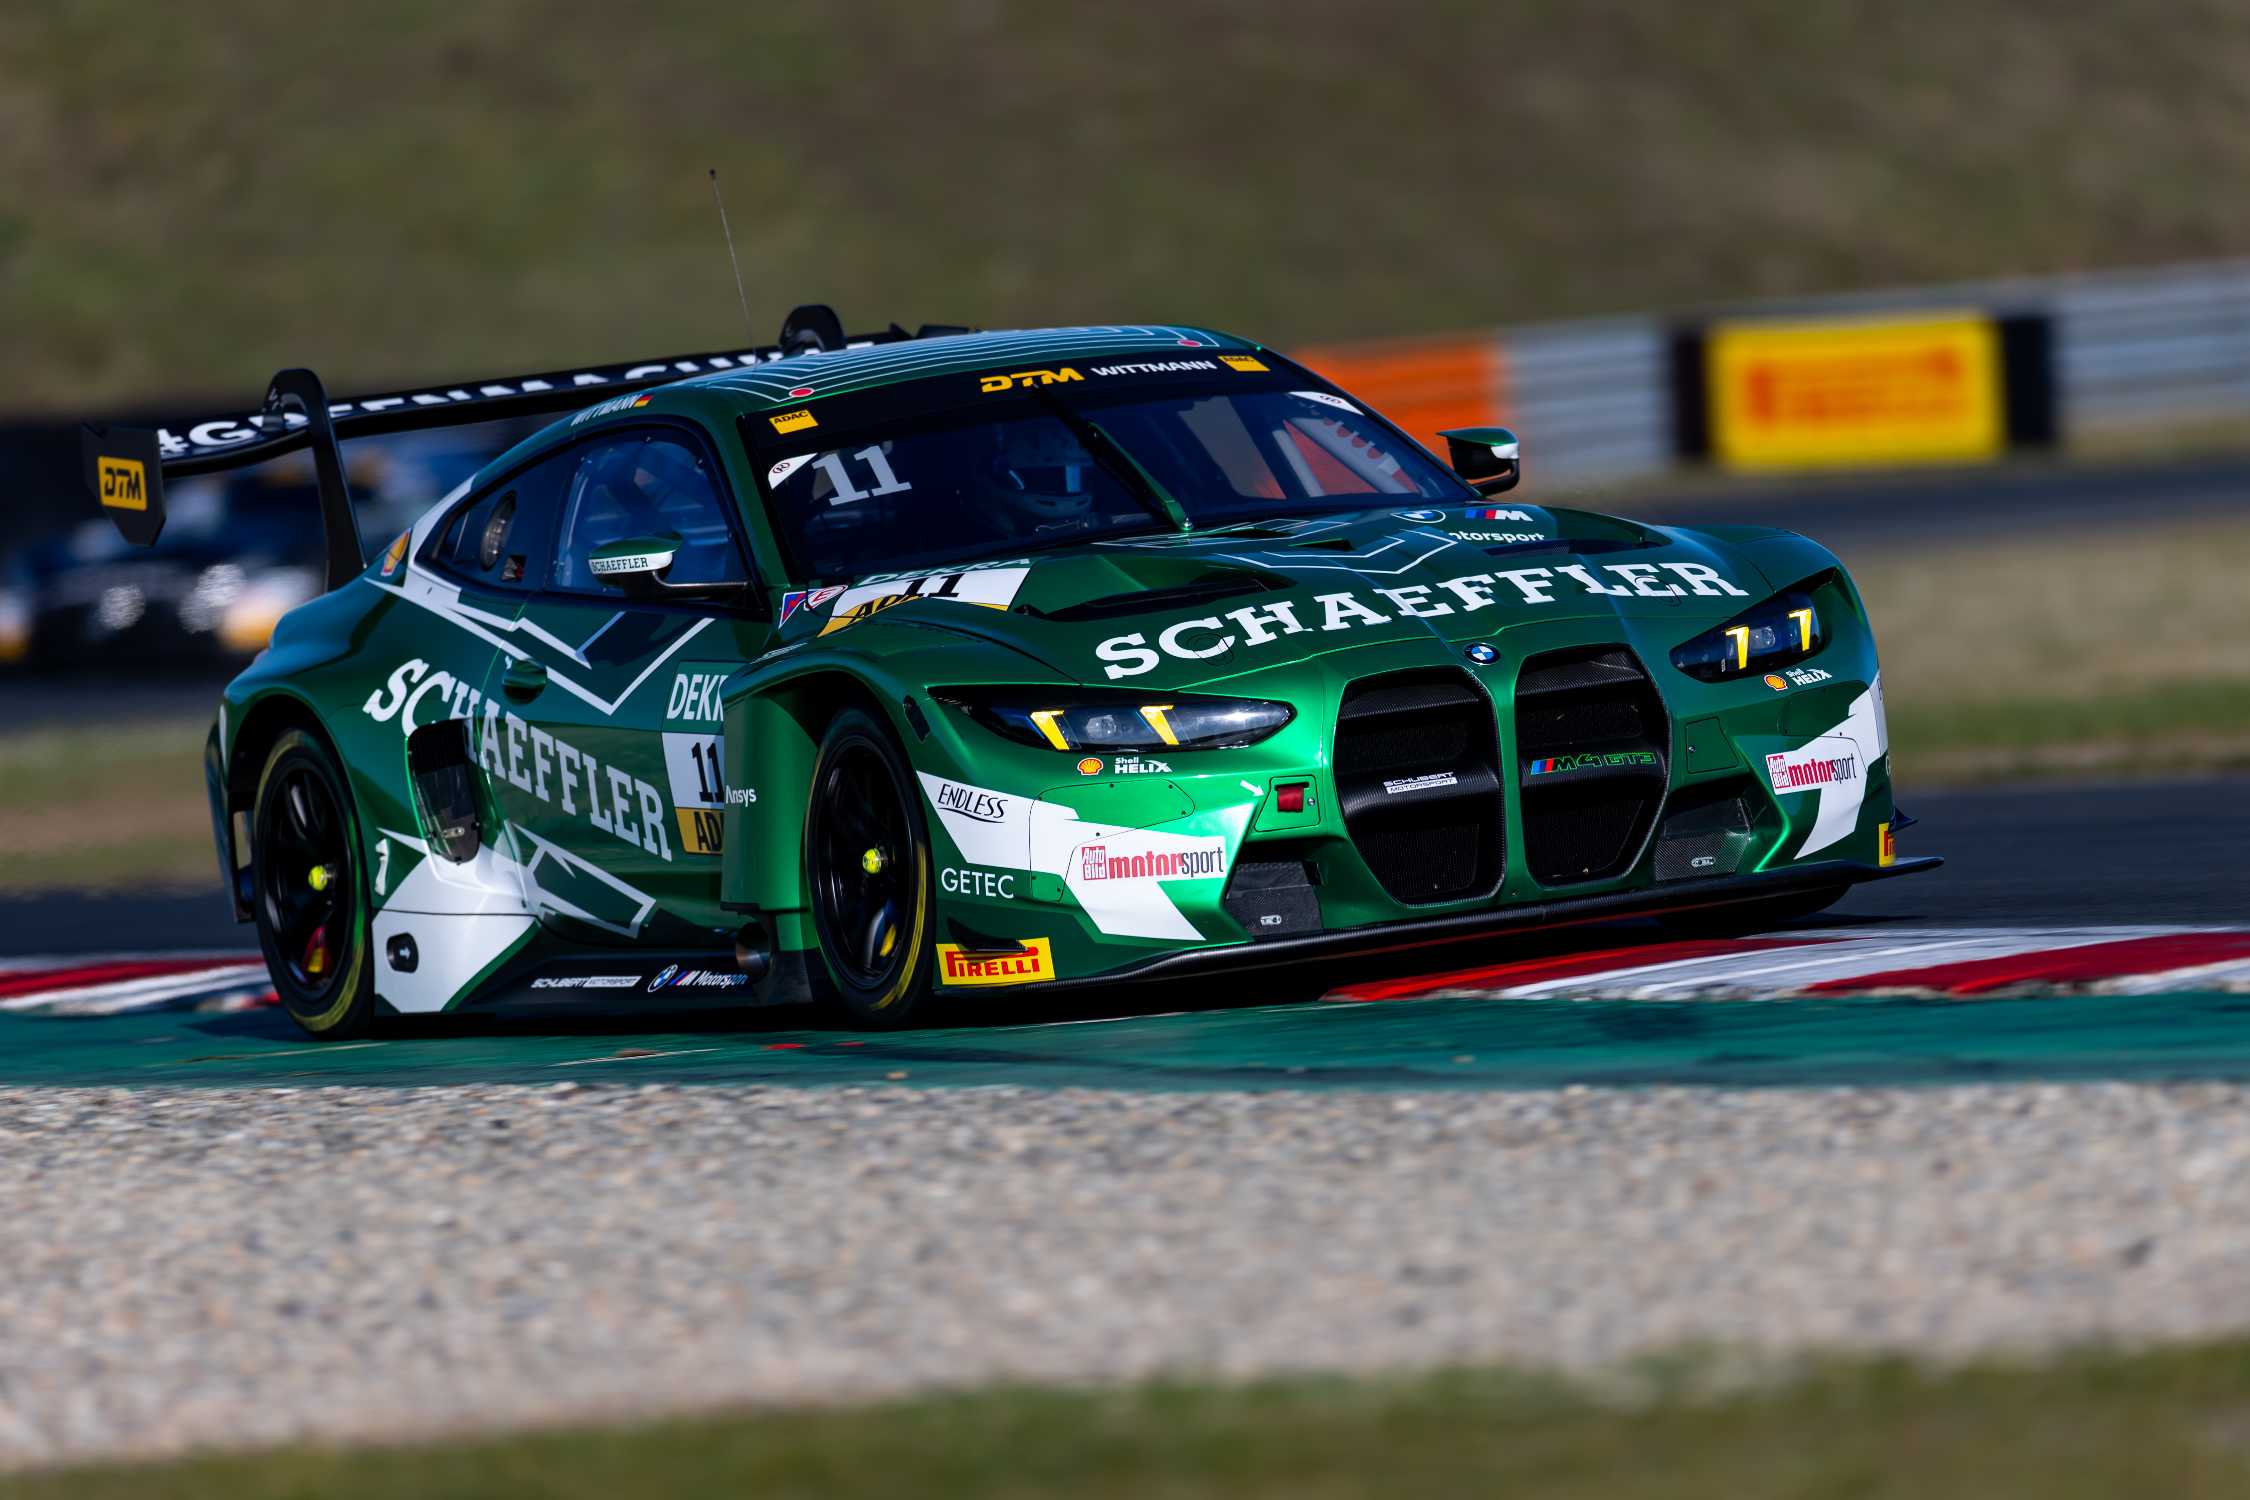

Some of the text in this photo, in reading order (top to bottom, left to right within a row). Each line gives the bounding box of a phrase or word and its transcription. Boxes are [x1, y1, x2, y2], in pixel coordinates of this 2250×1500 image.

[980, 360, 1218, 393] DTM WITTMANN
[774, 411, 809, 424] ADAC
[104, 466, 142, 501] DTM
[812, 445, 912, 506] 11
[591, 557, 649, 572] SCHAEFFLER
[902, 573, 966, 598] 11
[1095, 561, 1749, 680] SCHAEFFLER
[1791, 668, 1833, 687] HELIX
[362, 658, 673, 863] SCHAEFFLER
[691, 742, 725, 803] 11
[1115, 757, 1139, 765] Shell
[1115, 760, 1173, 774] HELIX
[1603, 752, 1657, 766] GT3
[1787, 753, 1857, 787] motorsport
[1383, 771, 1454, 787] SCHUBERT
[1389, 779, 1454, 792] MOTORSPORT
[725, 784, 757, 807] Ansys
[938, 783, 1008, 818] ENDLESS
[693, 811, 725, 851] AD
[1082, 846, 1106, 865] Auto
[1108, 847, 1224, 879] motorsport
[941, 867, 1014, 899] GETEC
[945, 947, 1041, 977] PIRELLI
